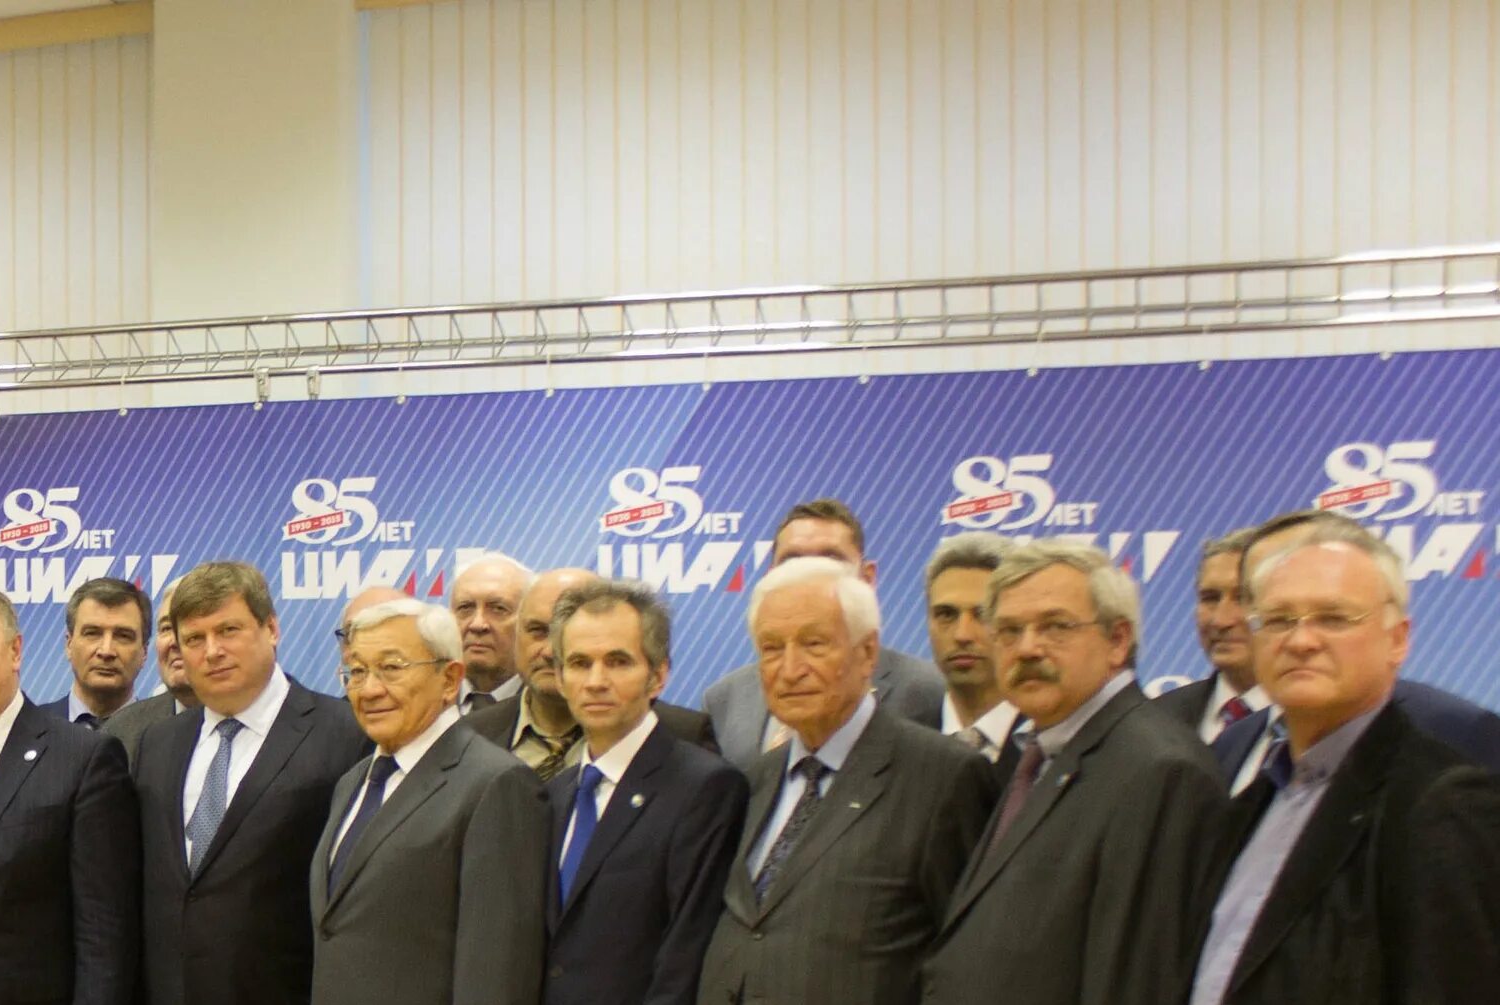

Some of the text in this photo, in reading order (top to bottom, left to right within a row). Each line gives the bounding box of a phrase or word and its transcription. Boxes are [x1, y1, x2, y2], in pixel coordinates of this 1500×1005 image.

[292, 477, 415, 546] 85 ЛЕТ
[609, 466, 744, 538] 85 ЛЕТ
[953, 454, 1055, 530] 85
[1044, 503, 1099, 526] ЛЕТ
[1325, 440, 1437, 521] 85
[1424, 490, 1485, 516] ЛЕТ
[3, 487, 115, 553] 85 ЛЕТ
